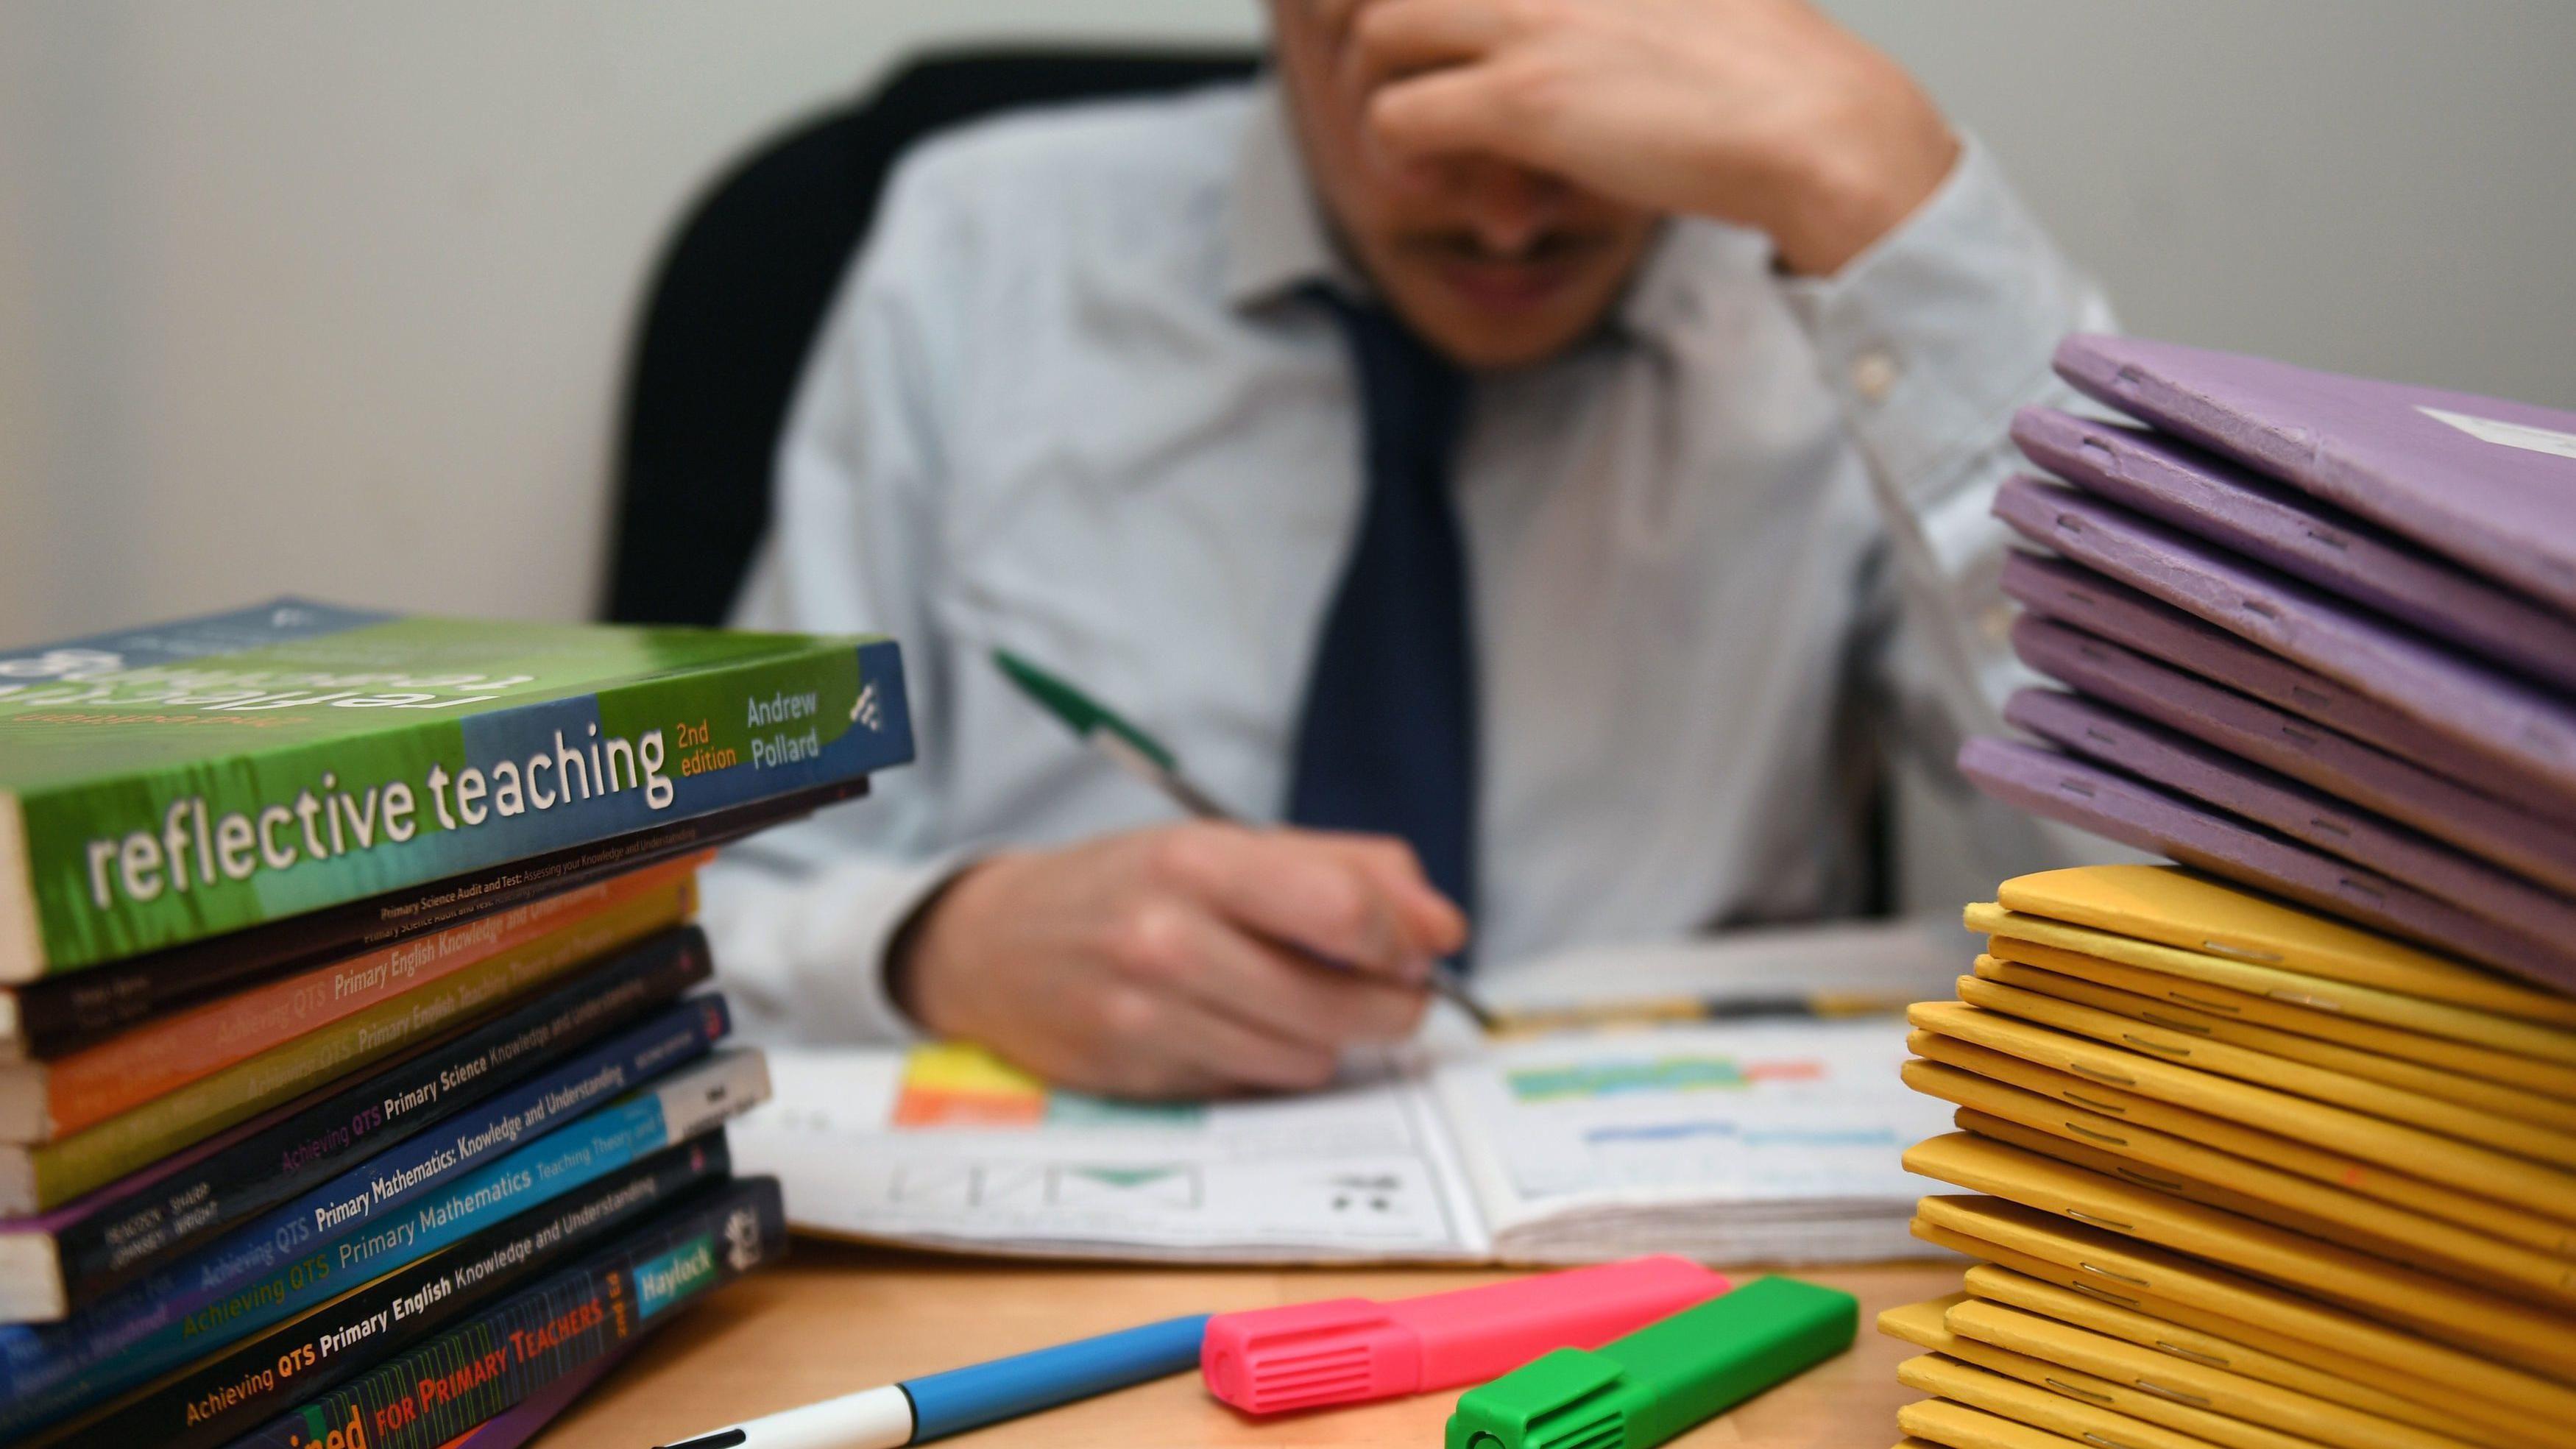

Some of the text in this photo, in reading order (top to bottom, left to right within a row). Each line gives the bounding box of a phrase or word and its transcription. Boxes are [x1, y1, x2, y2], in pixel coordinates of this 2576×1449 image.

[677, 718, 710, 748] 2nd
[747, 691, 818, 728] Andrew
[751, 727, 819, 770] Pollard
[681, 747, 737, 777] edition
[87, 723, 675, 910] reflective teaching
[381, 901, 420, 920] Primary
[420, 891, 456, 910] Science
[457, 882, 483, 900] Audit
[484, 877, 500, 893] and
[501, 874, 523, 888] Test:
[523, 863, 562, 882] Assessing
[562, 858, 580, 874] your
[581, 846, 624, 866] Knowledge
[625, 841, 640, 854] and
[294, 981, 327, 1018] QTS
[335, 961, 387, 1000] Primary
[392, 940, 434, 977] English
[439, 918, 503, 957] Knowledge
[358, 1017, 410, 1053] Primary
[282, 1124, 350, 1172] Achieving
[352, 1105, 381, 1136] QTS
[383, 1080, 437, 1120] Primary
[440, 1055, 487, 1092] Science
[488, 1023, 551, 1066] Knowledge
[200, 1064, 625, 1290] Achieving QTS Primary Mathematics: Knowledge and Understanding
[183, 1277, 285, 1339] Achieving
[289, 1254, 330, 1292] QTS
[339, 1220, 414, 1269] Primary
[419, 1168, 532, 1233] Mathematics
[536, 1146, 592, 1181] Teaching
[186, 1176, 657, 1428] Achieving QTS Primary English Knowledge and Understanding
[375, 1396, 417, 1436] FOR
[419, 1345, 508, 1414] PRIMARY
[509, 1297, 604, 1364] TEACHERS
[641, 1245, 712, 1302] Haylock
